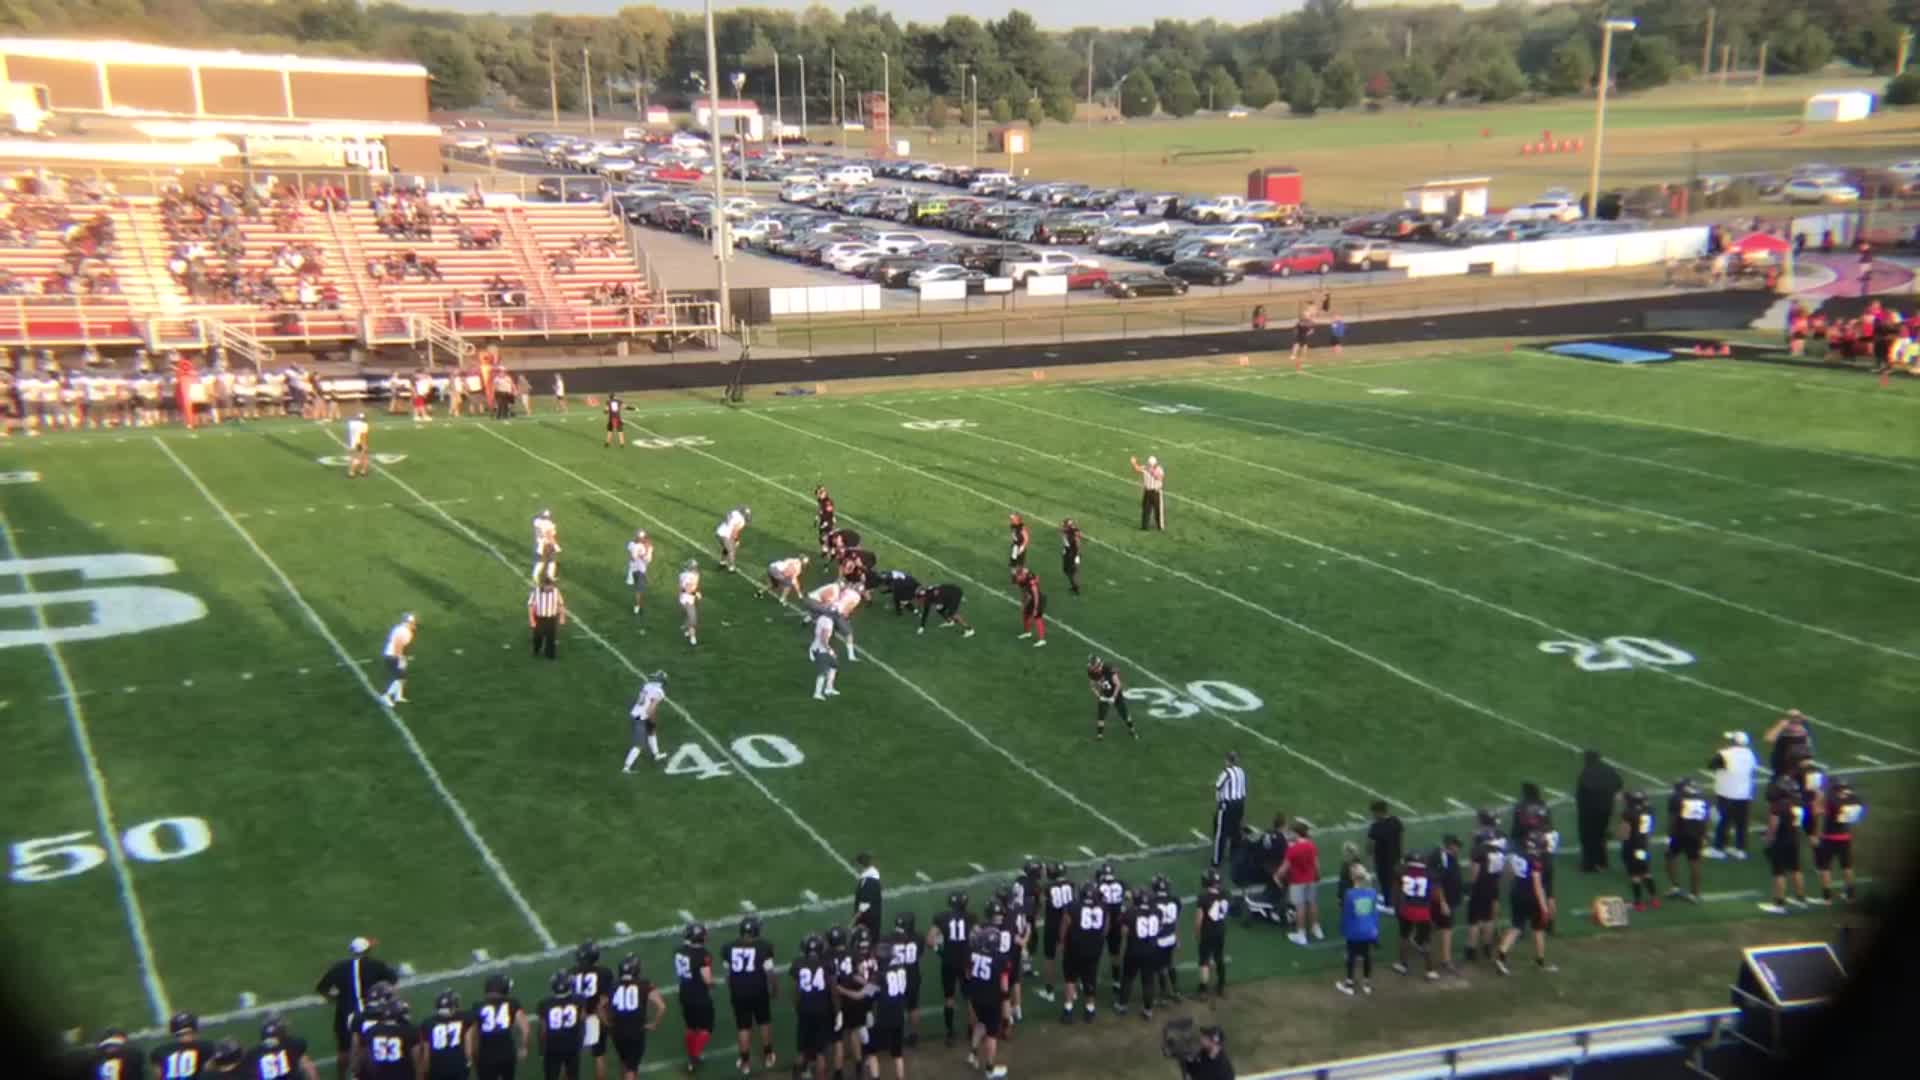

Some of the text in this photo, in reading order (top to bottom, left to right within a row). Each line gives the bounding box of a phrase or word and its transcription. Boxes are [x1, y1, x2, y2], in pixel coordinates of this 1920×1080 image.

[1537, 635, 1696, 671] 20
[1122, 680, 1264, 719] 30
[664, 734, 805, 780] 40
[9, 816, 212, 882] 50
[949, 918, 966, 941] 11
[731, 947, 757, 973] 57
[971, 952, 993, 981] 75
[799, 967, 825, 992] 24
[612, 984, 639, 1011] 40
[479, 1002, 511, 1033] 34
[371, 1035, 402, 1063] 53
